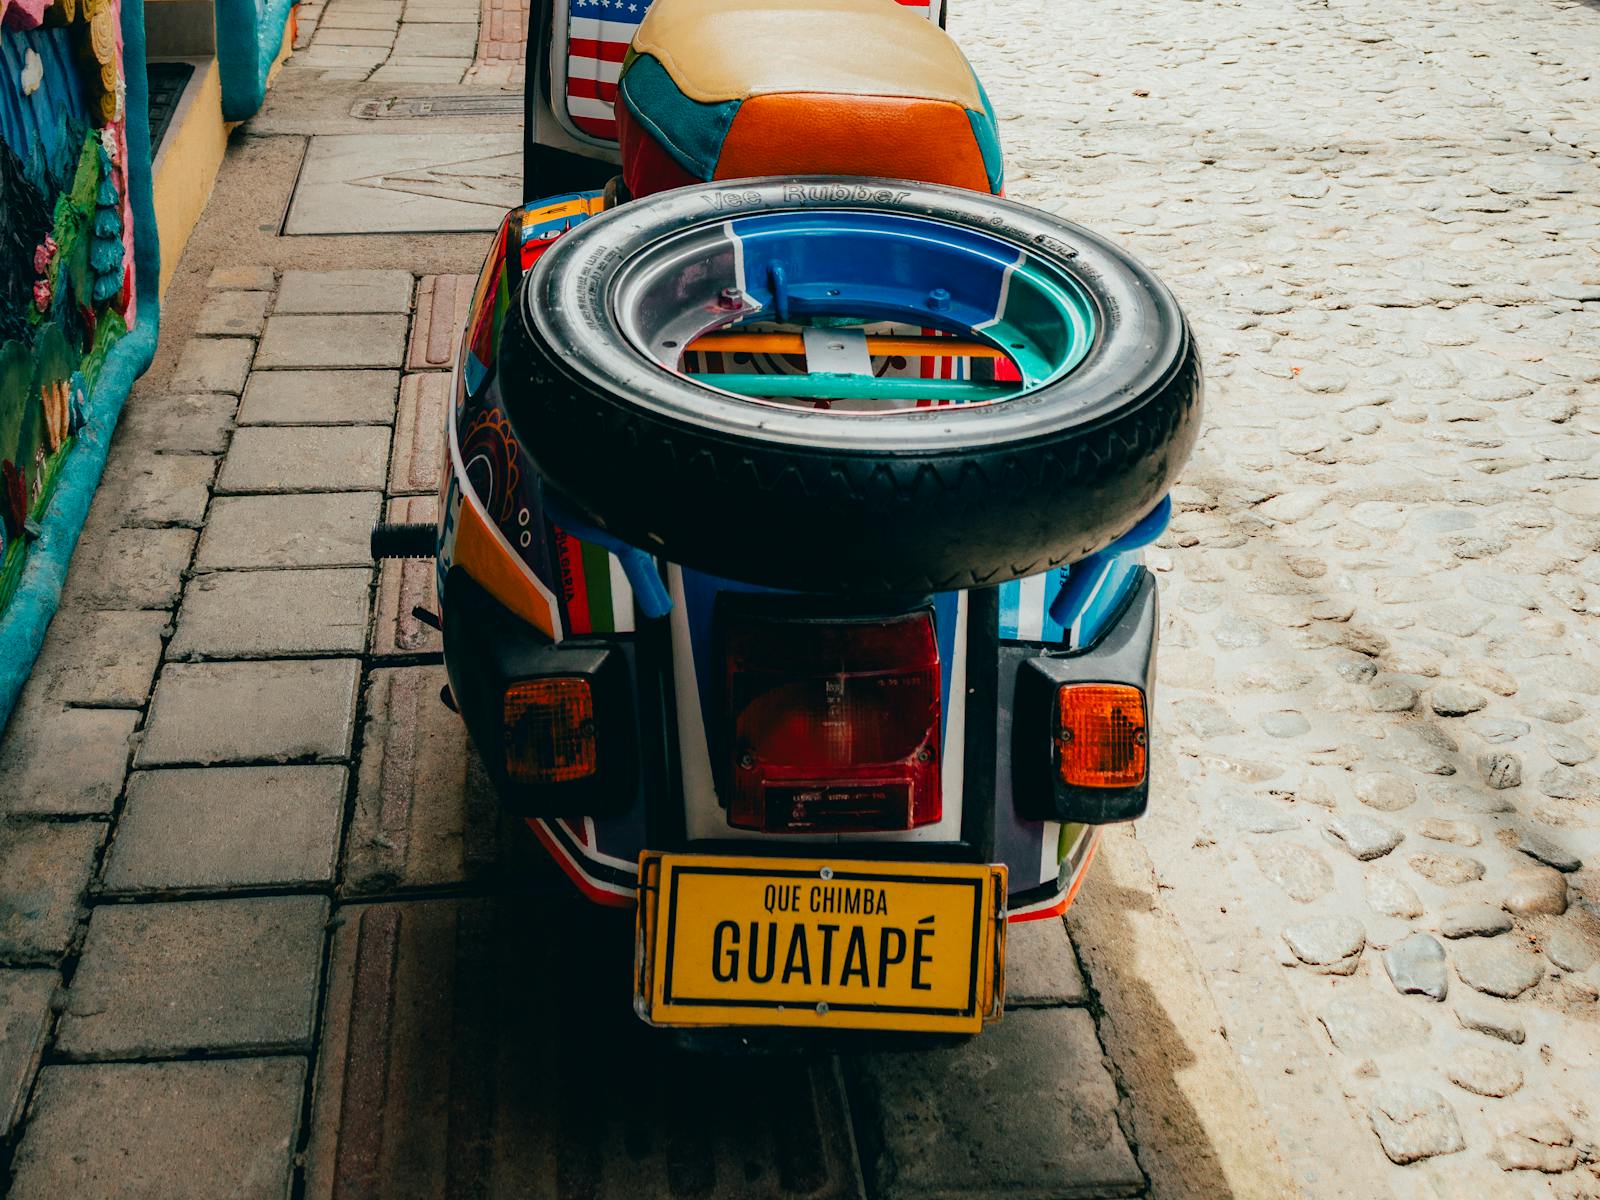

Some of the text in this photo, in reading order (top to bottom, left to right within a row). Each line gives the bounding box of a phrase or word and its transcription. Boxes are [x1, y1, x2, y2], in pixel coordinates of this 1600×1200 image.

[701, 183, 911, 211] Vee Rubber
[764, 883, 888, 916] QUE CHIMBA
[711, 915, 935, 991] GUATAPÉ
